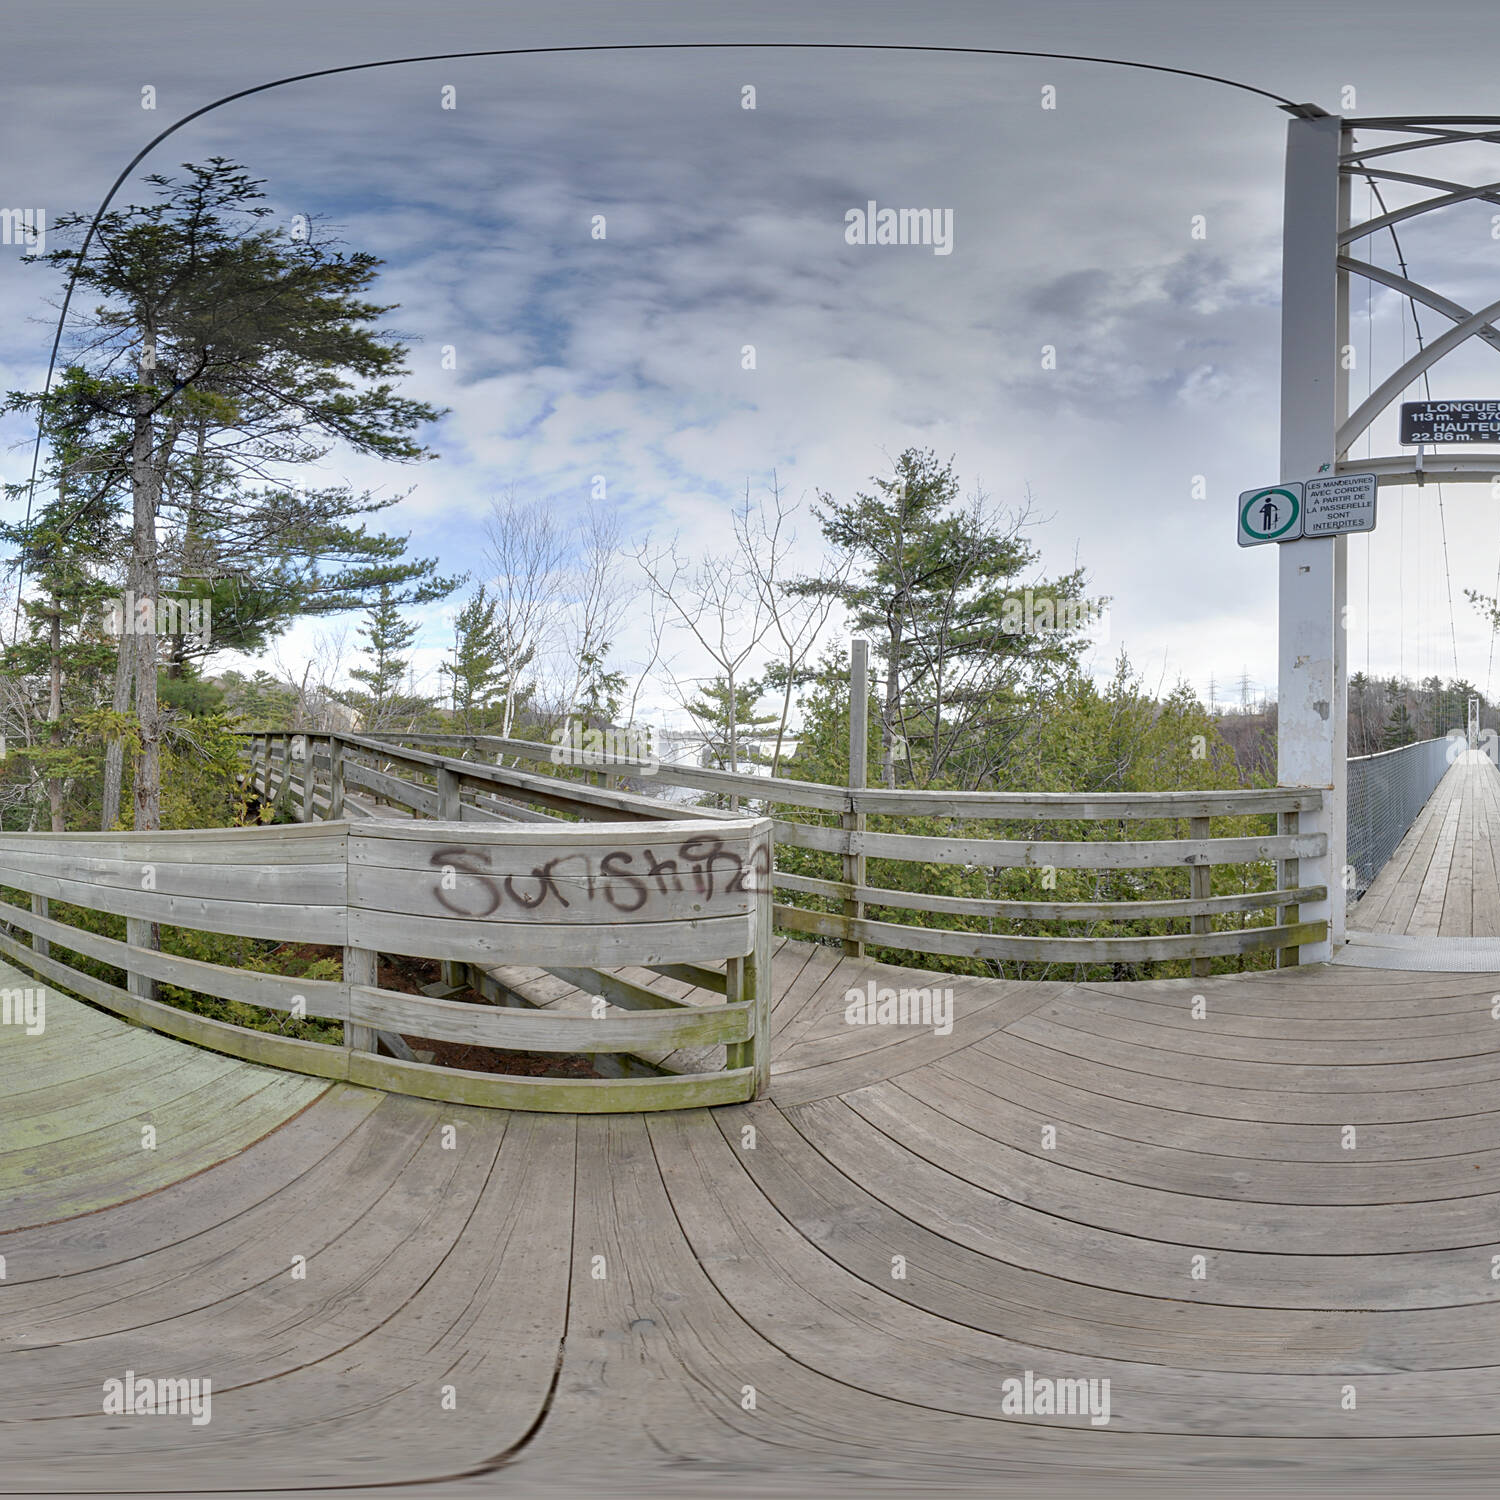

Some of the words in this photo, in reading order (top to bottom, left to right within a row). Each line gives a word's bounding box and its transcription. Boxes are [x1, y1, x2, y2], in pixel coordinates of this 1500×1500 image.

[1311, 489, 1332, 497] AVEC
[1334, 485, 1370, 495] CORDES
[1322, 495, 1351, 504] PARTIR
[1320, 501, 1372, 512] PASSERELLE
[1327, 511, 1350, 520] SONT
[1312, 518, 1365, 530] INTERDITES
